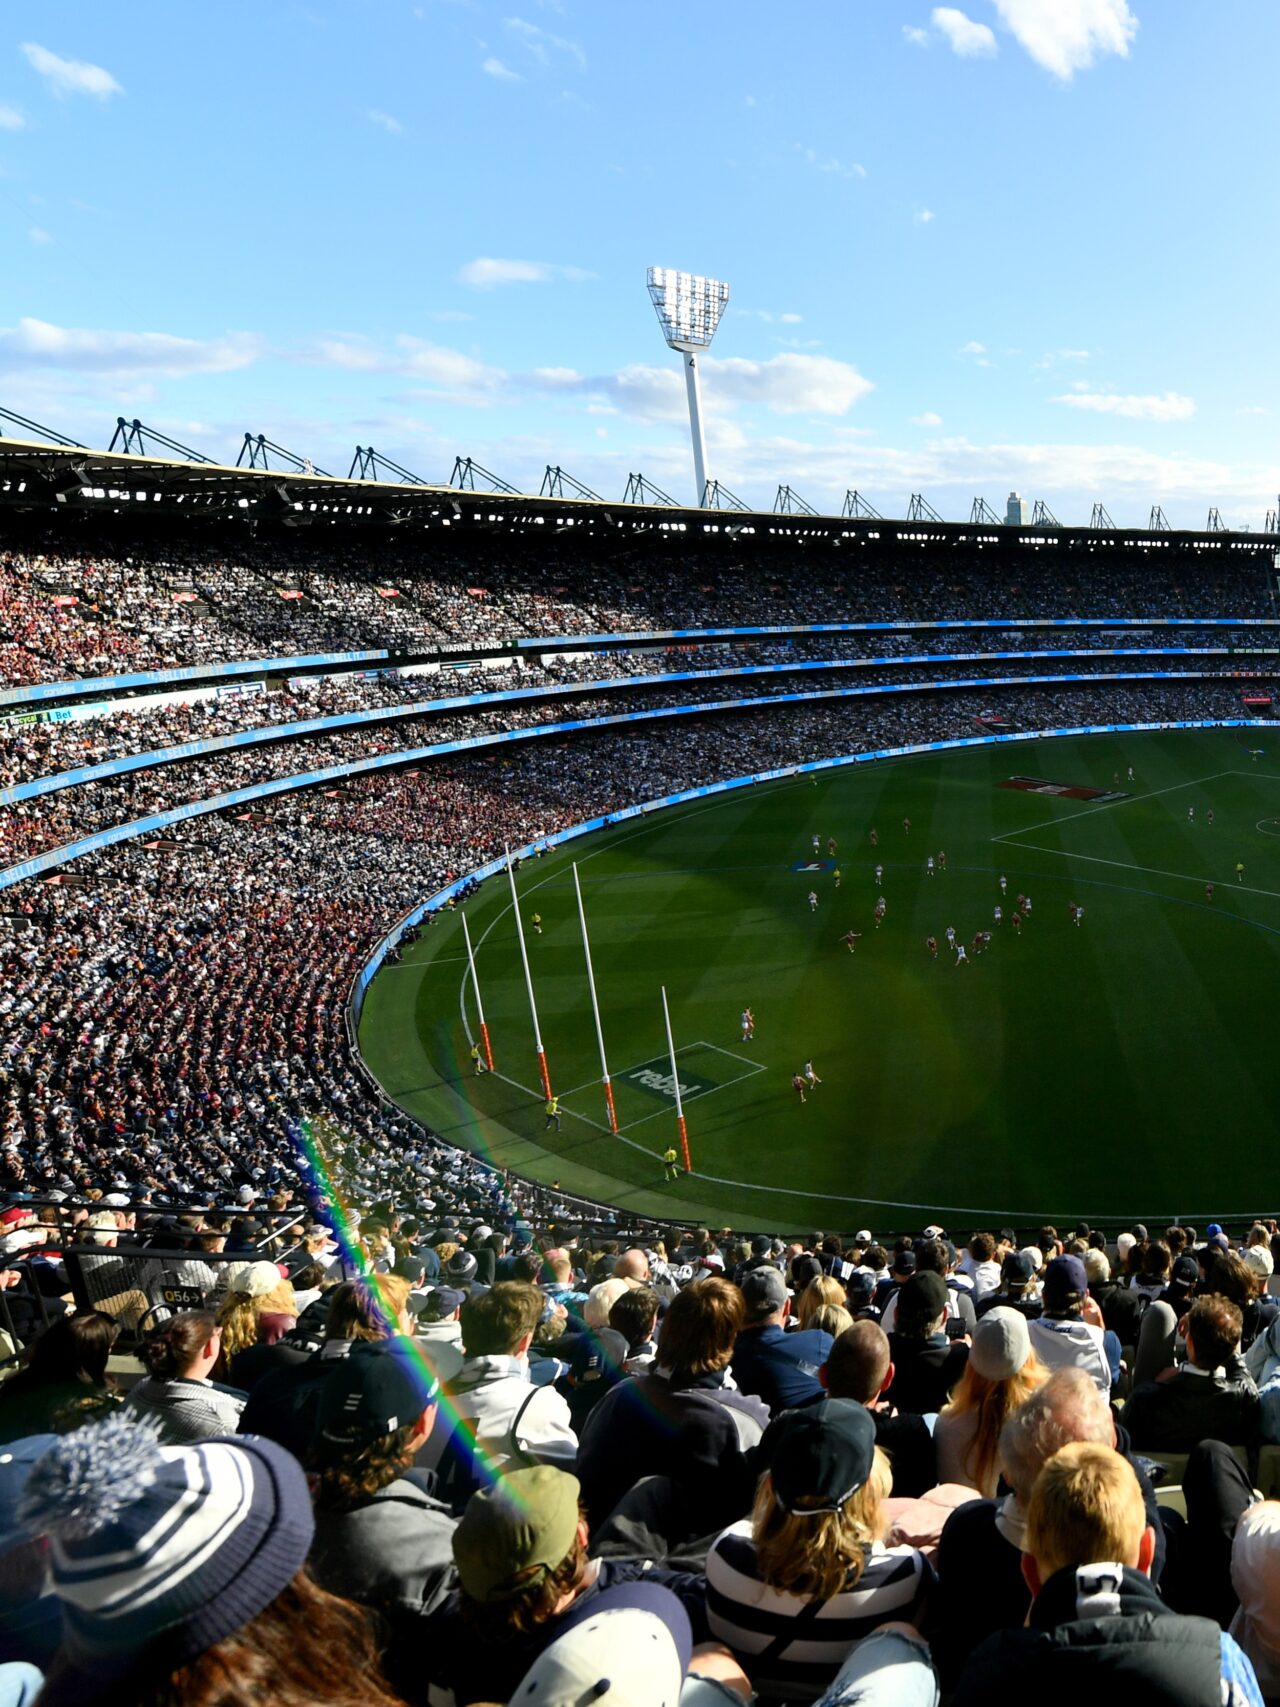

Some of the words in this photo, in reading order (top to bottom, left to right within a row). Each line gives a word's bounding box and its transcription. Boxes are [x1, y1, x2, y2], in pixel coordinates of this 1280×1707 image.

[407, 646, 438, 656] SHANE
[440, 643, 473, 653] WARNE
[474, 640, 503, 650] STAND
[55, 710, 72, 720] Bet
[164, 1290, 191, 1303] Q56
